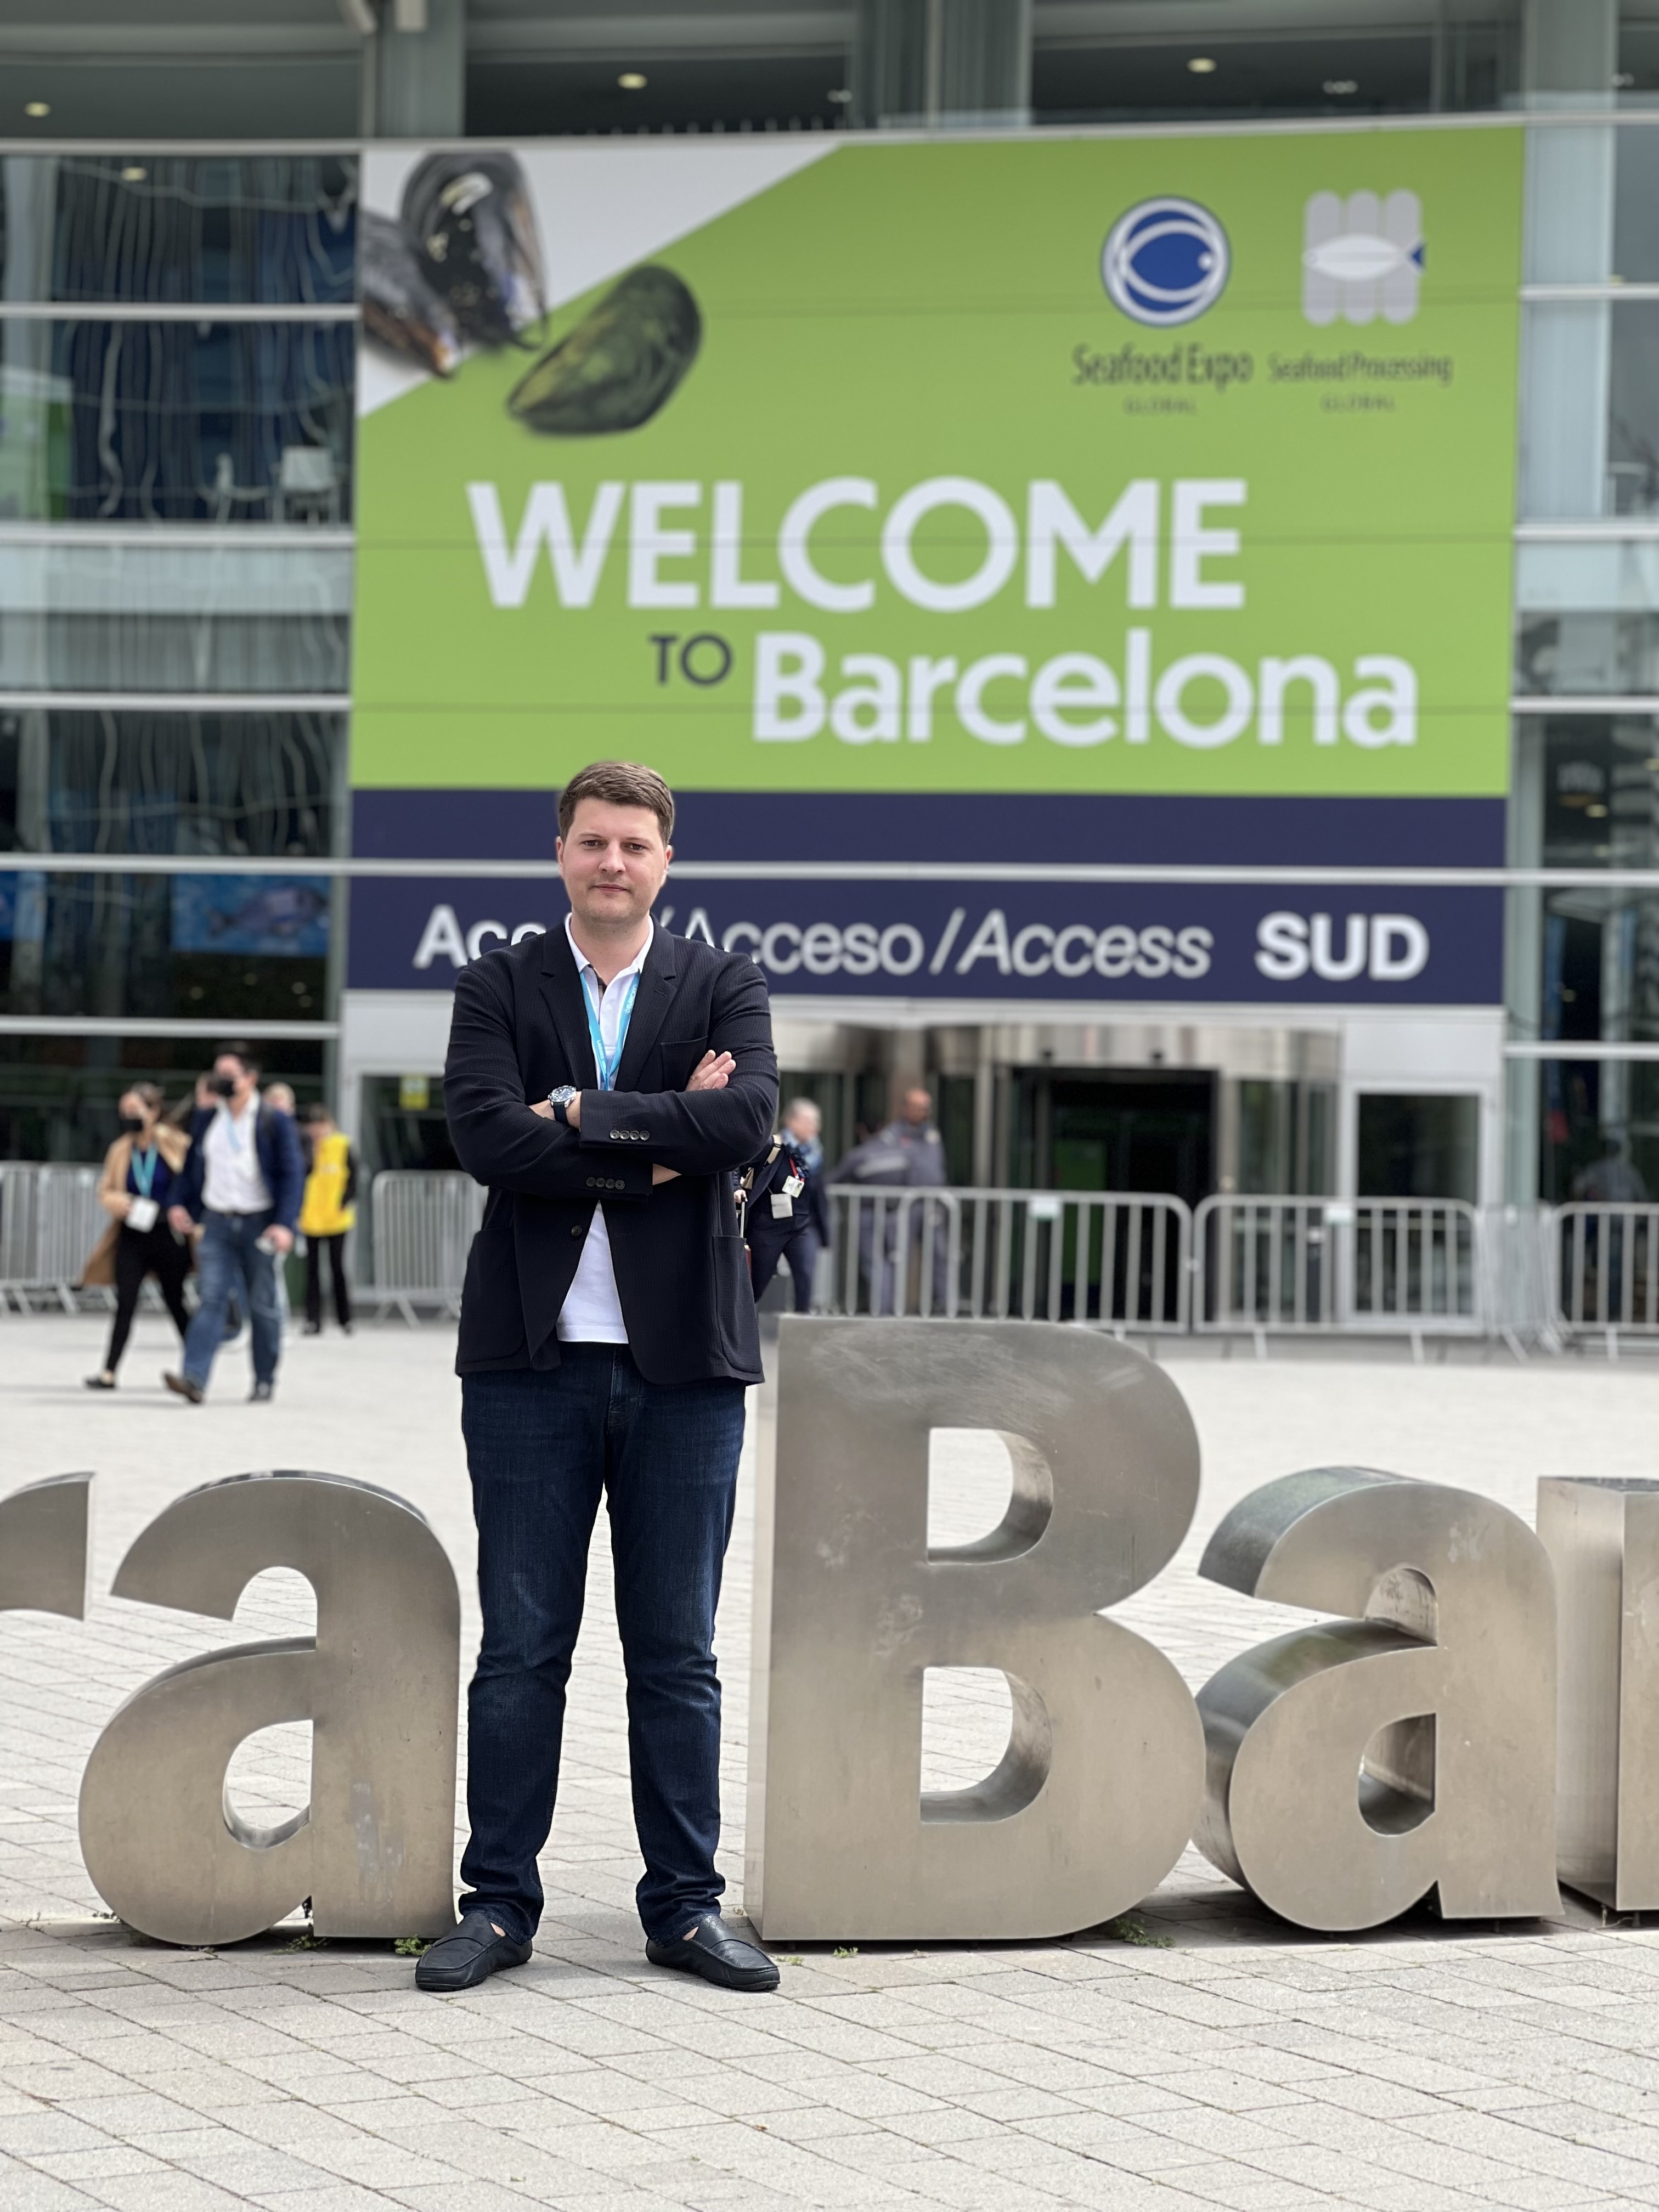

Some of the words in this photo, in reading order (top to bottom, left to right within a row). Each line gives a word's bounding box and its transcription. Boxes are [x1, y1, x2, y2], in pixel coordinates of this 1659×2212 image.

[1071, 341, 1183, 386] Seafood
[1186, 341, 1254, 395] Expo
[1267, 350, 1345, 383] Seafood
[1348, 350, 1454, 388] Processing
[466, 475, 1248, 612] WELCOME
[648, 632, 733, 687] TO
[753, 628, 1419, 748] Barcelona
[1254, 910, 1429, 981] SUD
